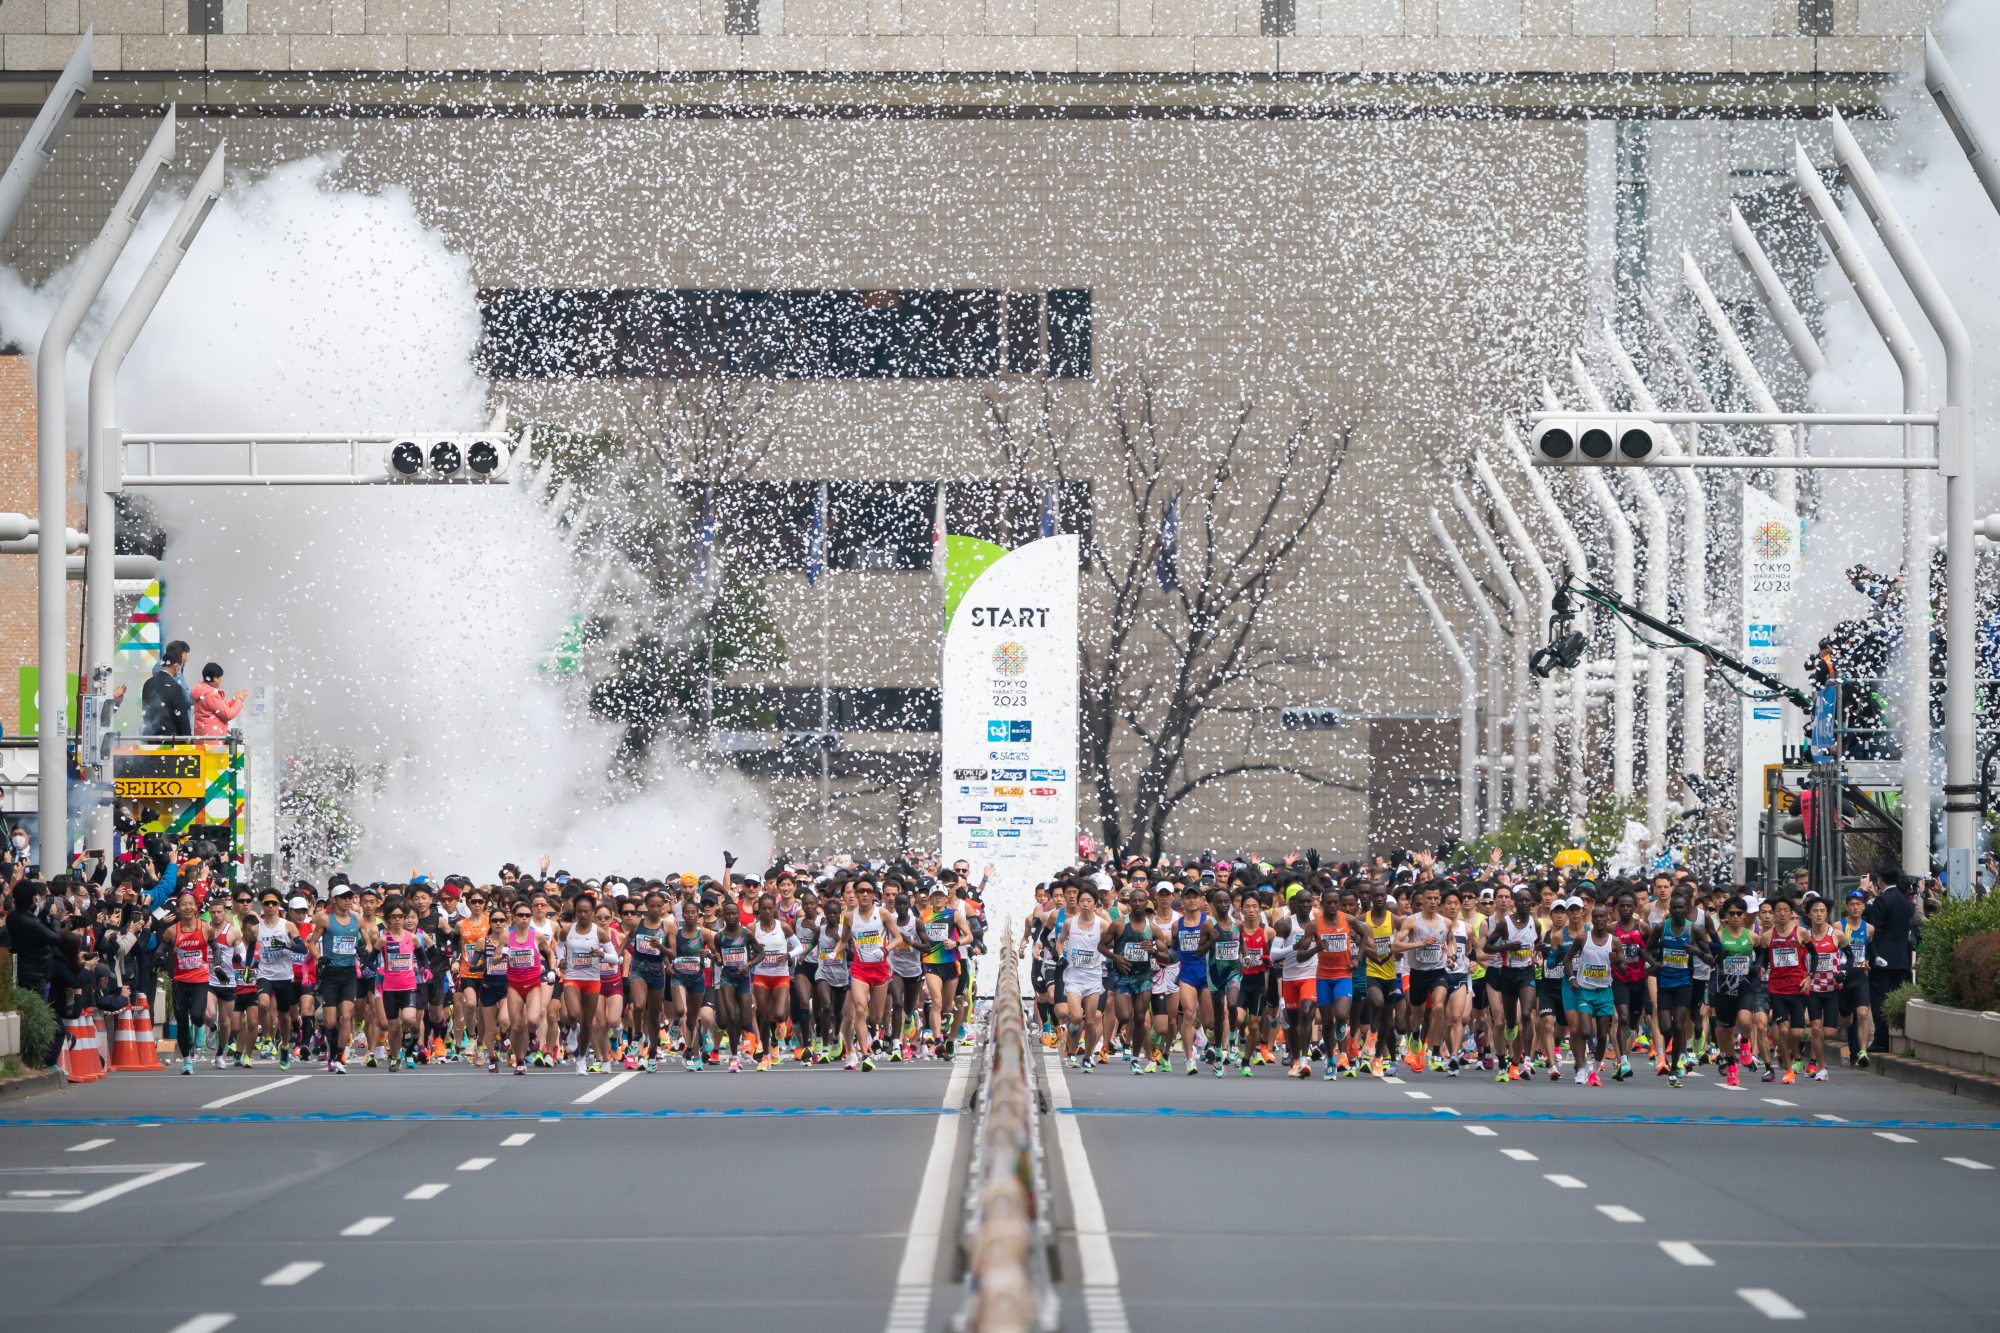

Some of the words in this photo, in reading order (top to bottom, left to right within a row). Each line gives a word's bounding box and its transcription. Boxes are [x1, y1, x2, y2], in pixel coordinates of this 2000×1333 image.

[1753, 563, 1791, 572] TOKYO
[1753, 580, 1791, 592] 2023
[971, 607, 1050, 628] START
[993, 680, 1028, 688] TOKYO
[993, 696, 1028, 706] 2023
[114, 781, 182, 796] SEIKO
